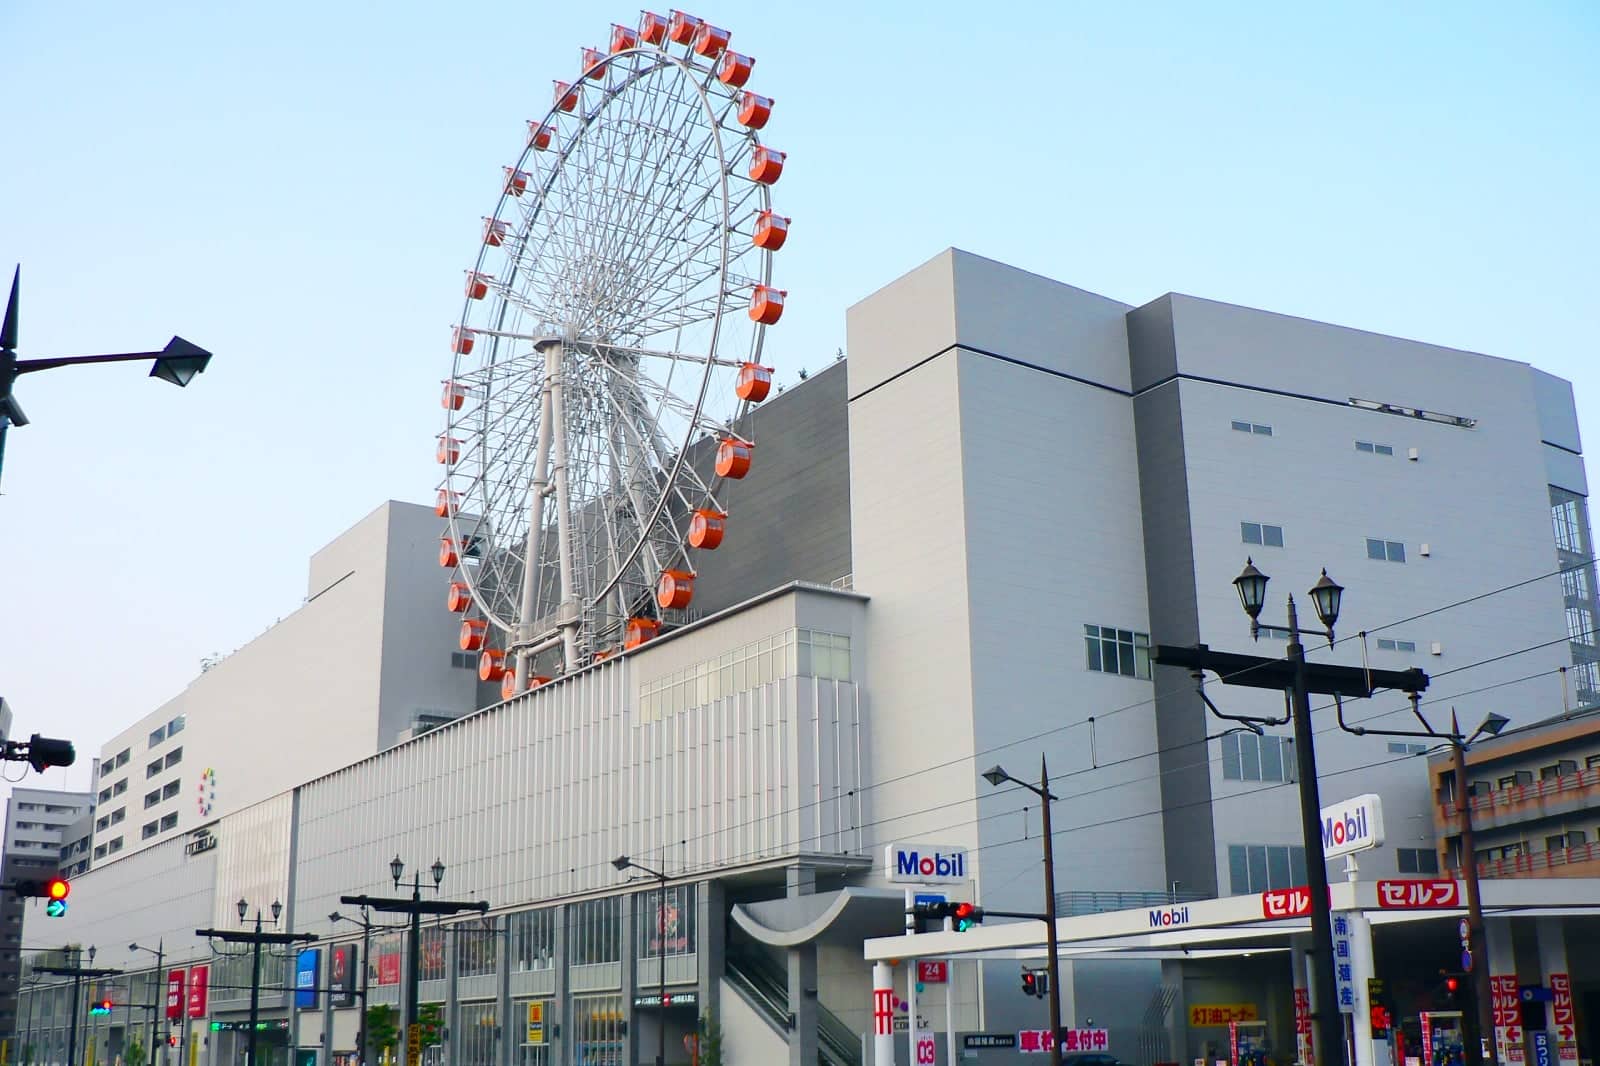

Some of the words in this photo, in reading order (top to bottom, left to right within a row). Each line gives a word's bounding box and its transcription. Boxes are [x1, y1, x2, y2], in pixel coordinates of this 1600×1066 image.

[1320, 806, 1367, 848] Mobil
[897, 851, 963, 877] Mobil
[1265, 891, 1309, 914] セル
[1381, 882, 1455, 905] セルフ
[1149, 906, 1189, 927] Mobil
[924, 963, 940, 975] 24
[1501, 979, 1519, 1023] セルフ
[1552, 977, 1571, 1022] セルフ
[1192, 1007, 1256, 1025] 灯油コーナー
